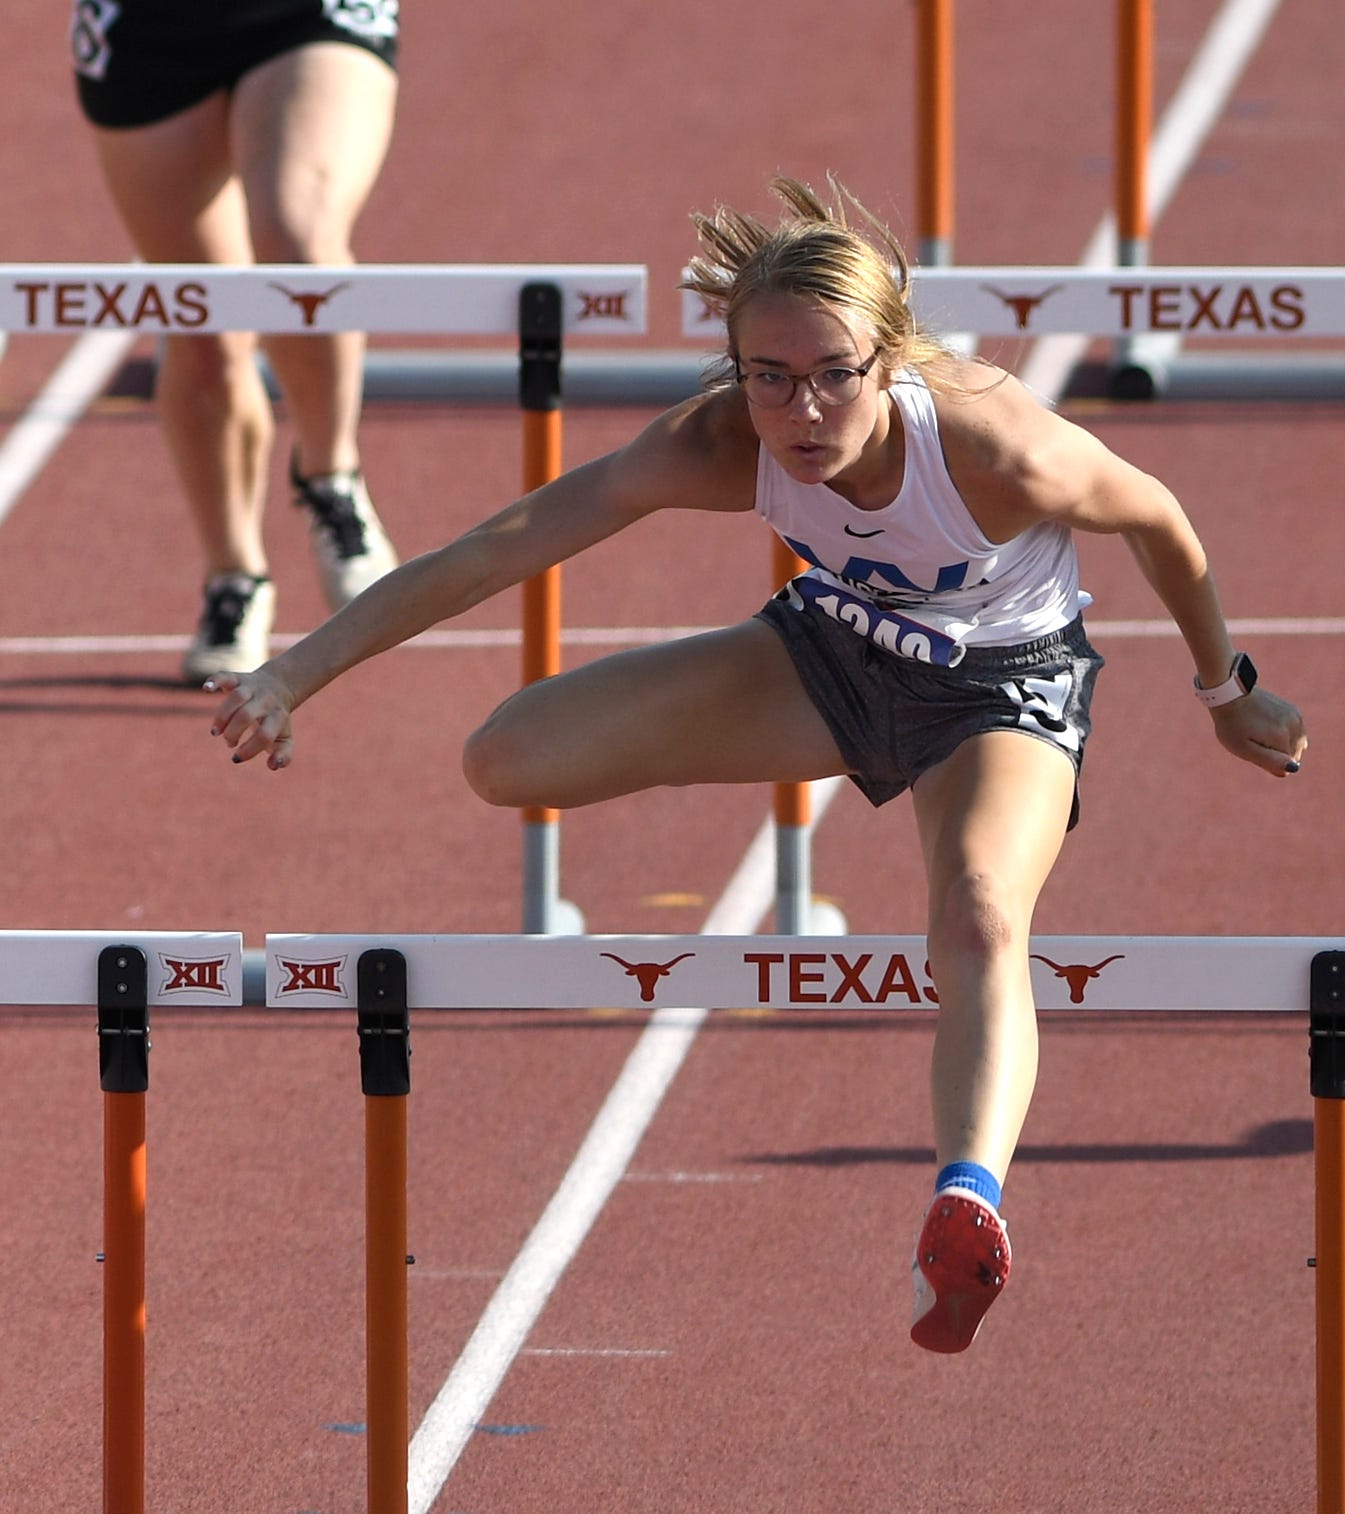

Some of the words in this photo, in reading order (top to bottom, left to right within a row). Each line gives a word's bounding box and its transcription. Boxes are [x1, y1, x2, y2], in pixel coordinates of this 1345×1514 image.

[14, 282, 209, 328] TEXAS
[578, 291, 627, 321] XII
[1108, 285, 1305, 331] TEXAS
[164, 958, 225, 992] XII
[281, 960, 342, 993] XII
